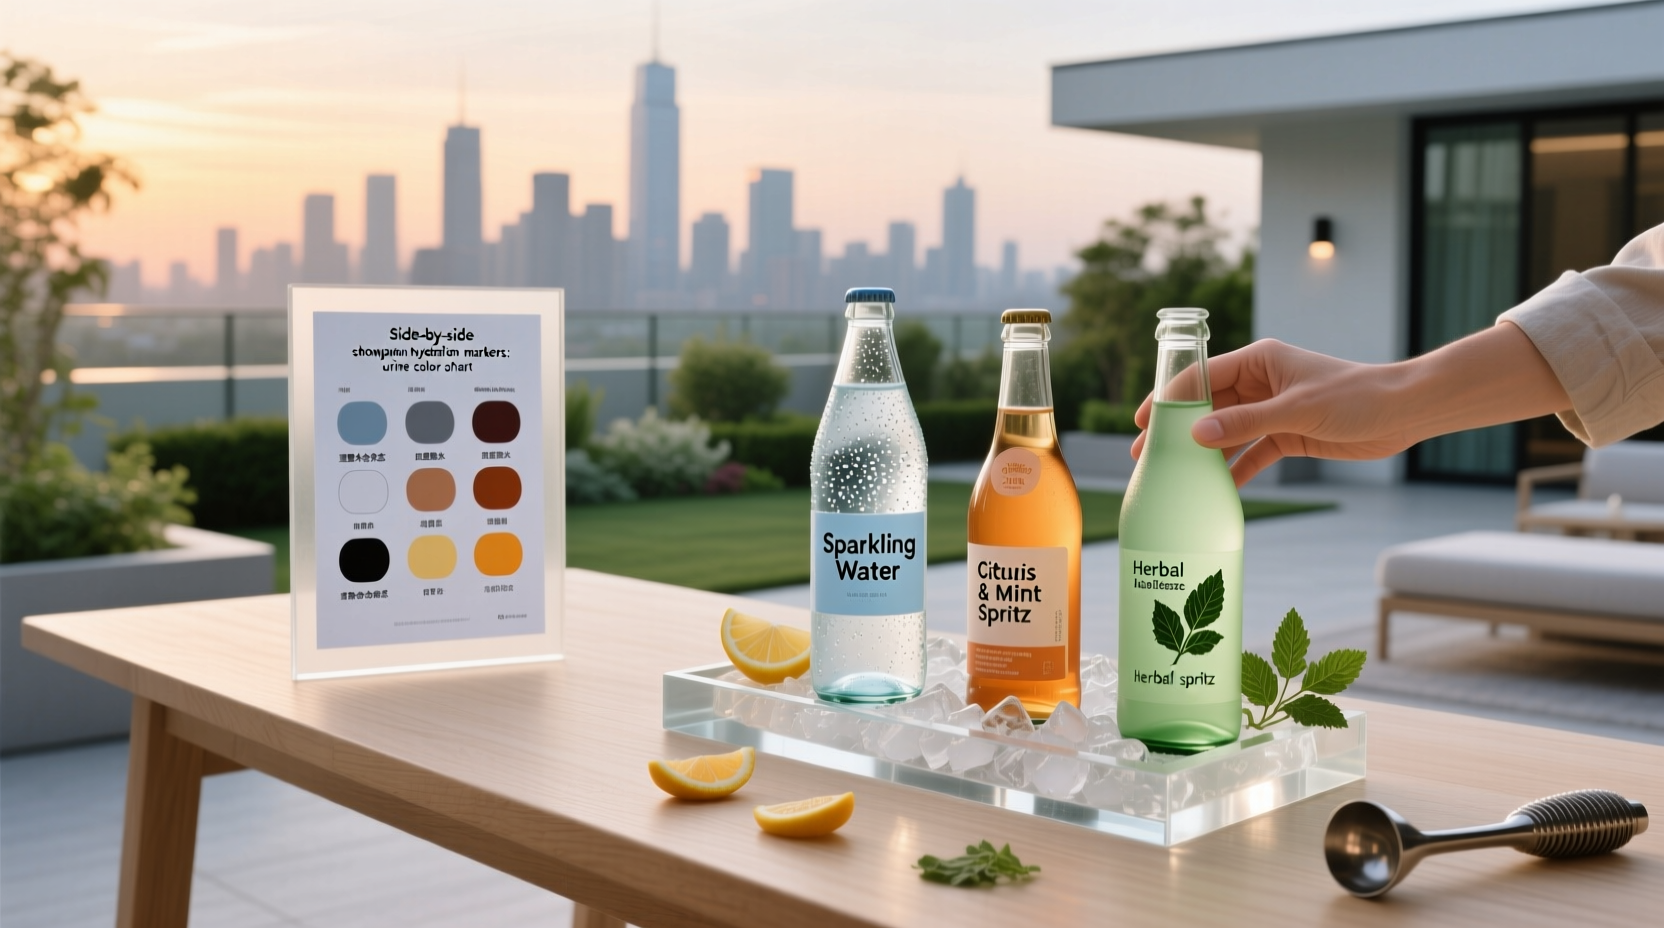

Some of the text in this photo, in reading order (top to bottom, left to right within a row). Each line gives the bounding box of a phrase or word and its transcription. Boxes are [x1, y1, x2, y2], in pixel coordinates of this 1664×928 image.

[464, 346, 510, 358] markers:
[413, 360, 441, 372] color
[823, 532, 916, 560] Sparkling
[835, 559, 901, 581] Water
[1133, 560, 1184, 578] Herbal
[978, 582, 1042, 602] & Mint
[978, 603, 1032, 627] Spritz
[1134, 669, 1216, 689] Herbal spritz
